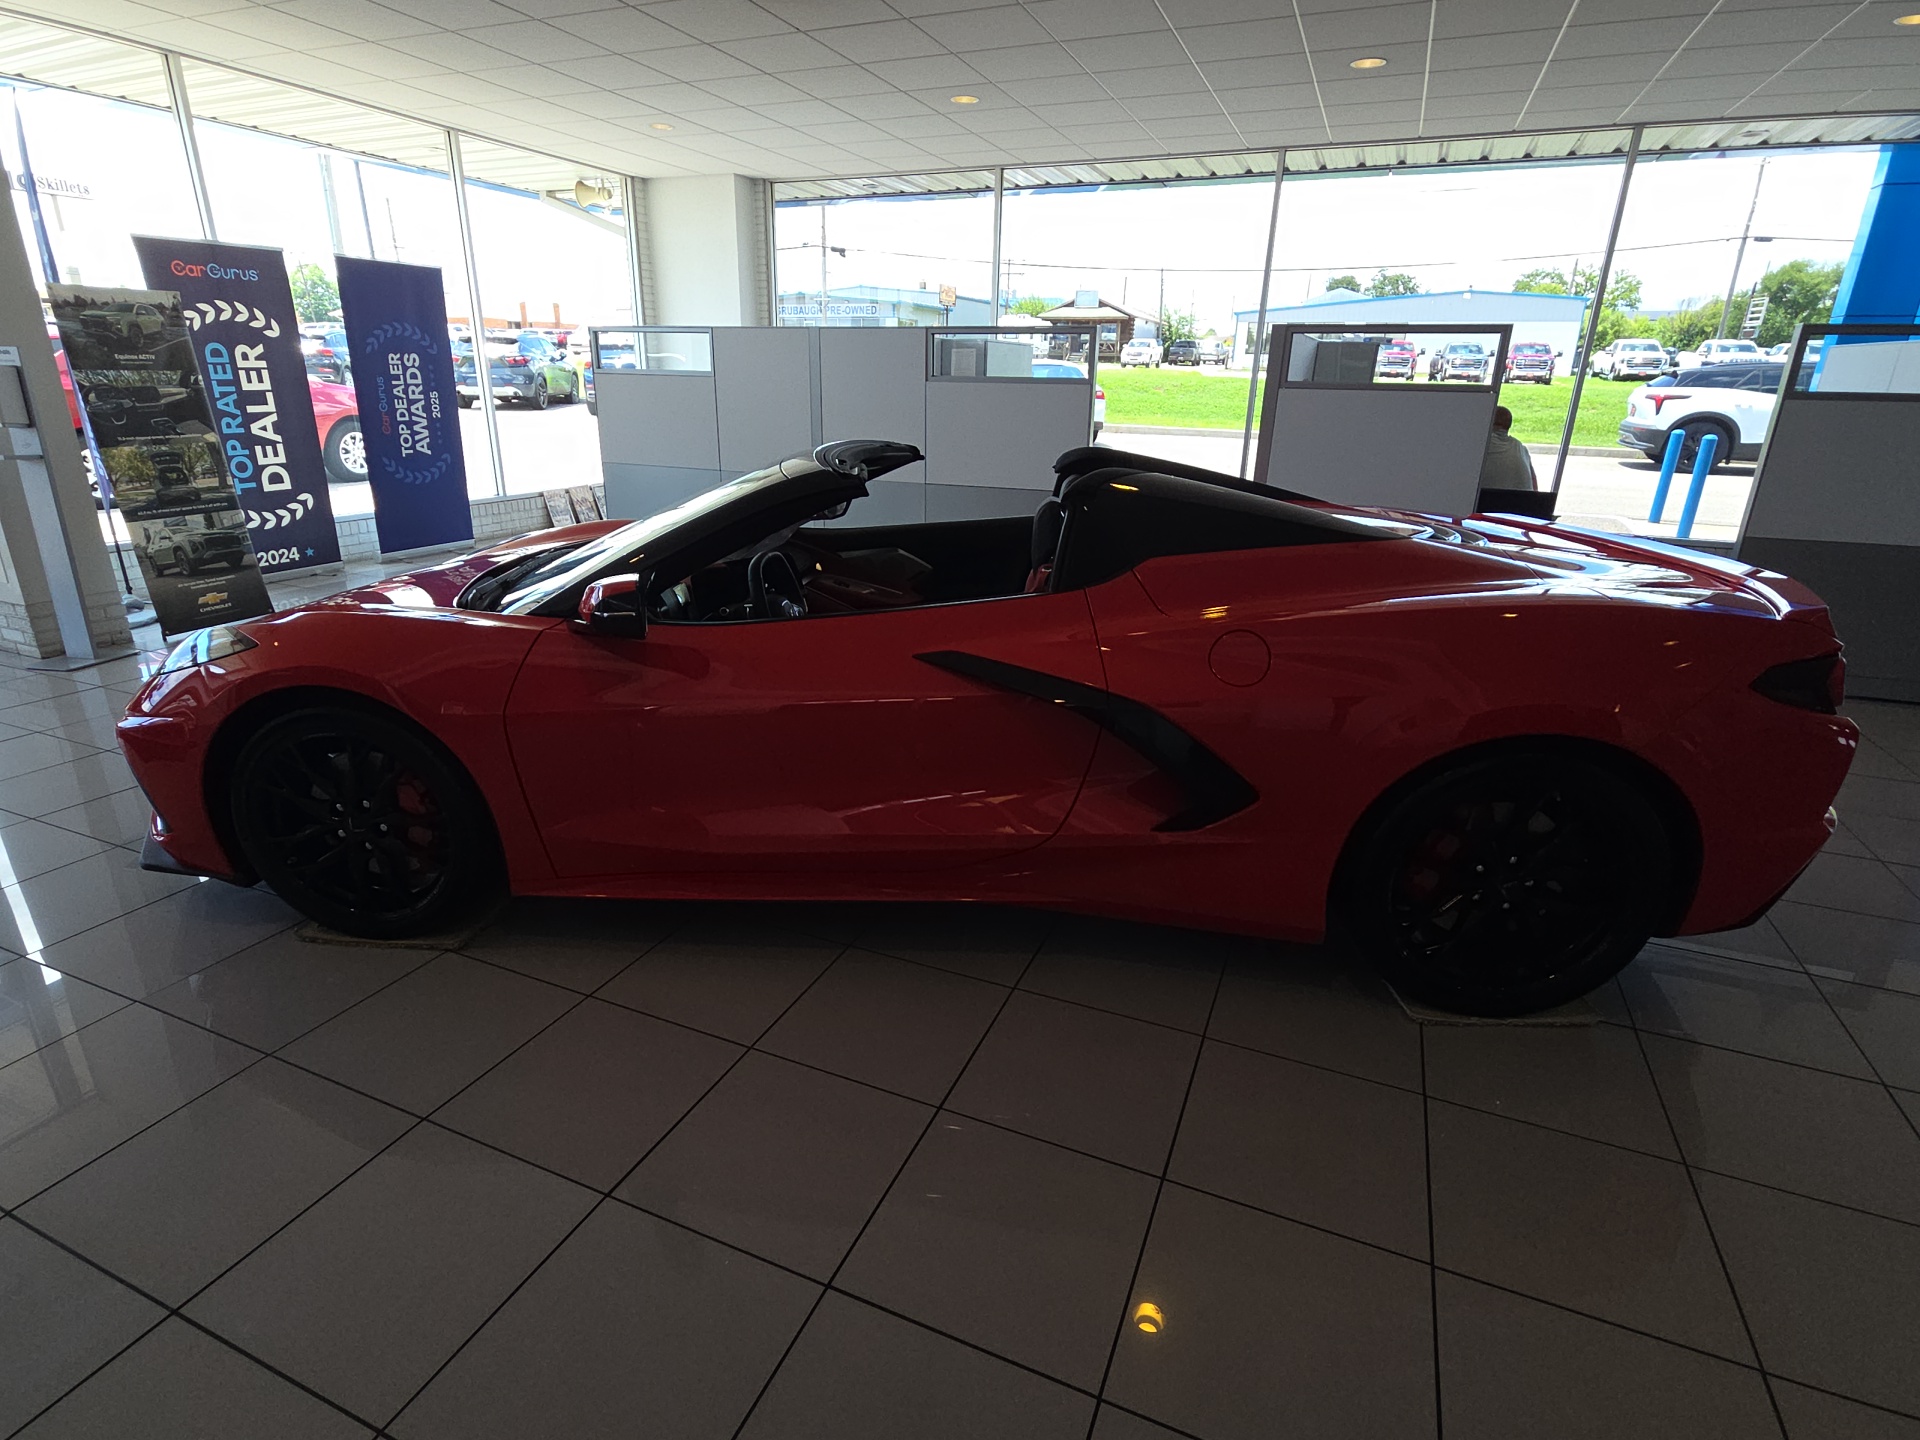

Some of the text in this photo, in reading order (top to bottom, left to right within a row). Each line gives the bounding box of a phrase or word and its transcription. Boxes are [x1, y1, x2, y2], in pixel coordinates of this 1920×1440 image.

[37, 176, 90, 195] Skillets
[170, 260, 258, 281] CarGurus
[204, 342, 257, 495] TOP RATED
[234, 343, 292, 492] DEALER
[376, 376, 391, 434] CarGurus
[388, 353, 414, 457] TOP DEALER
[404, 353, 432, 455] AWARDS
[430, 391, 441, 418] 2025
[257, 547, 299, 567] 2024
